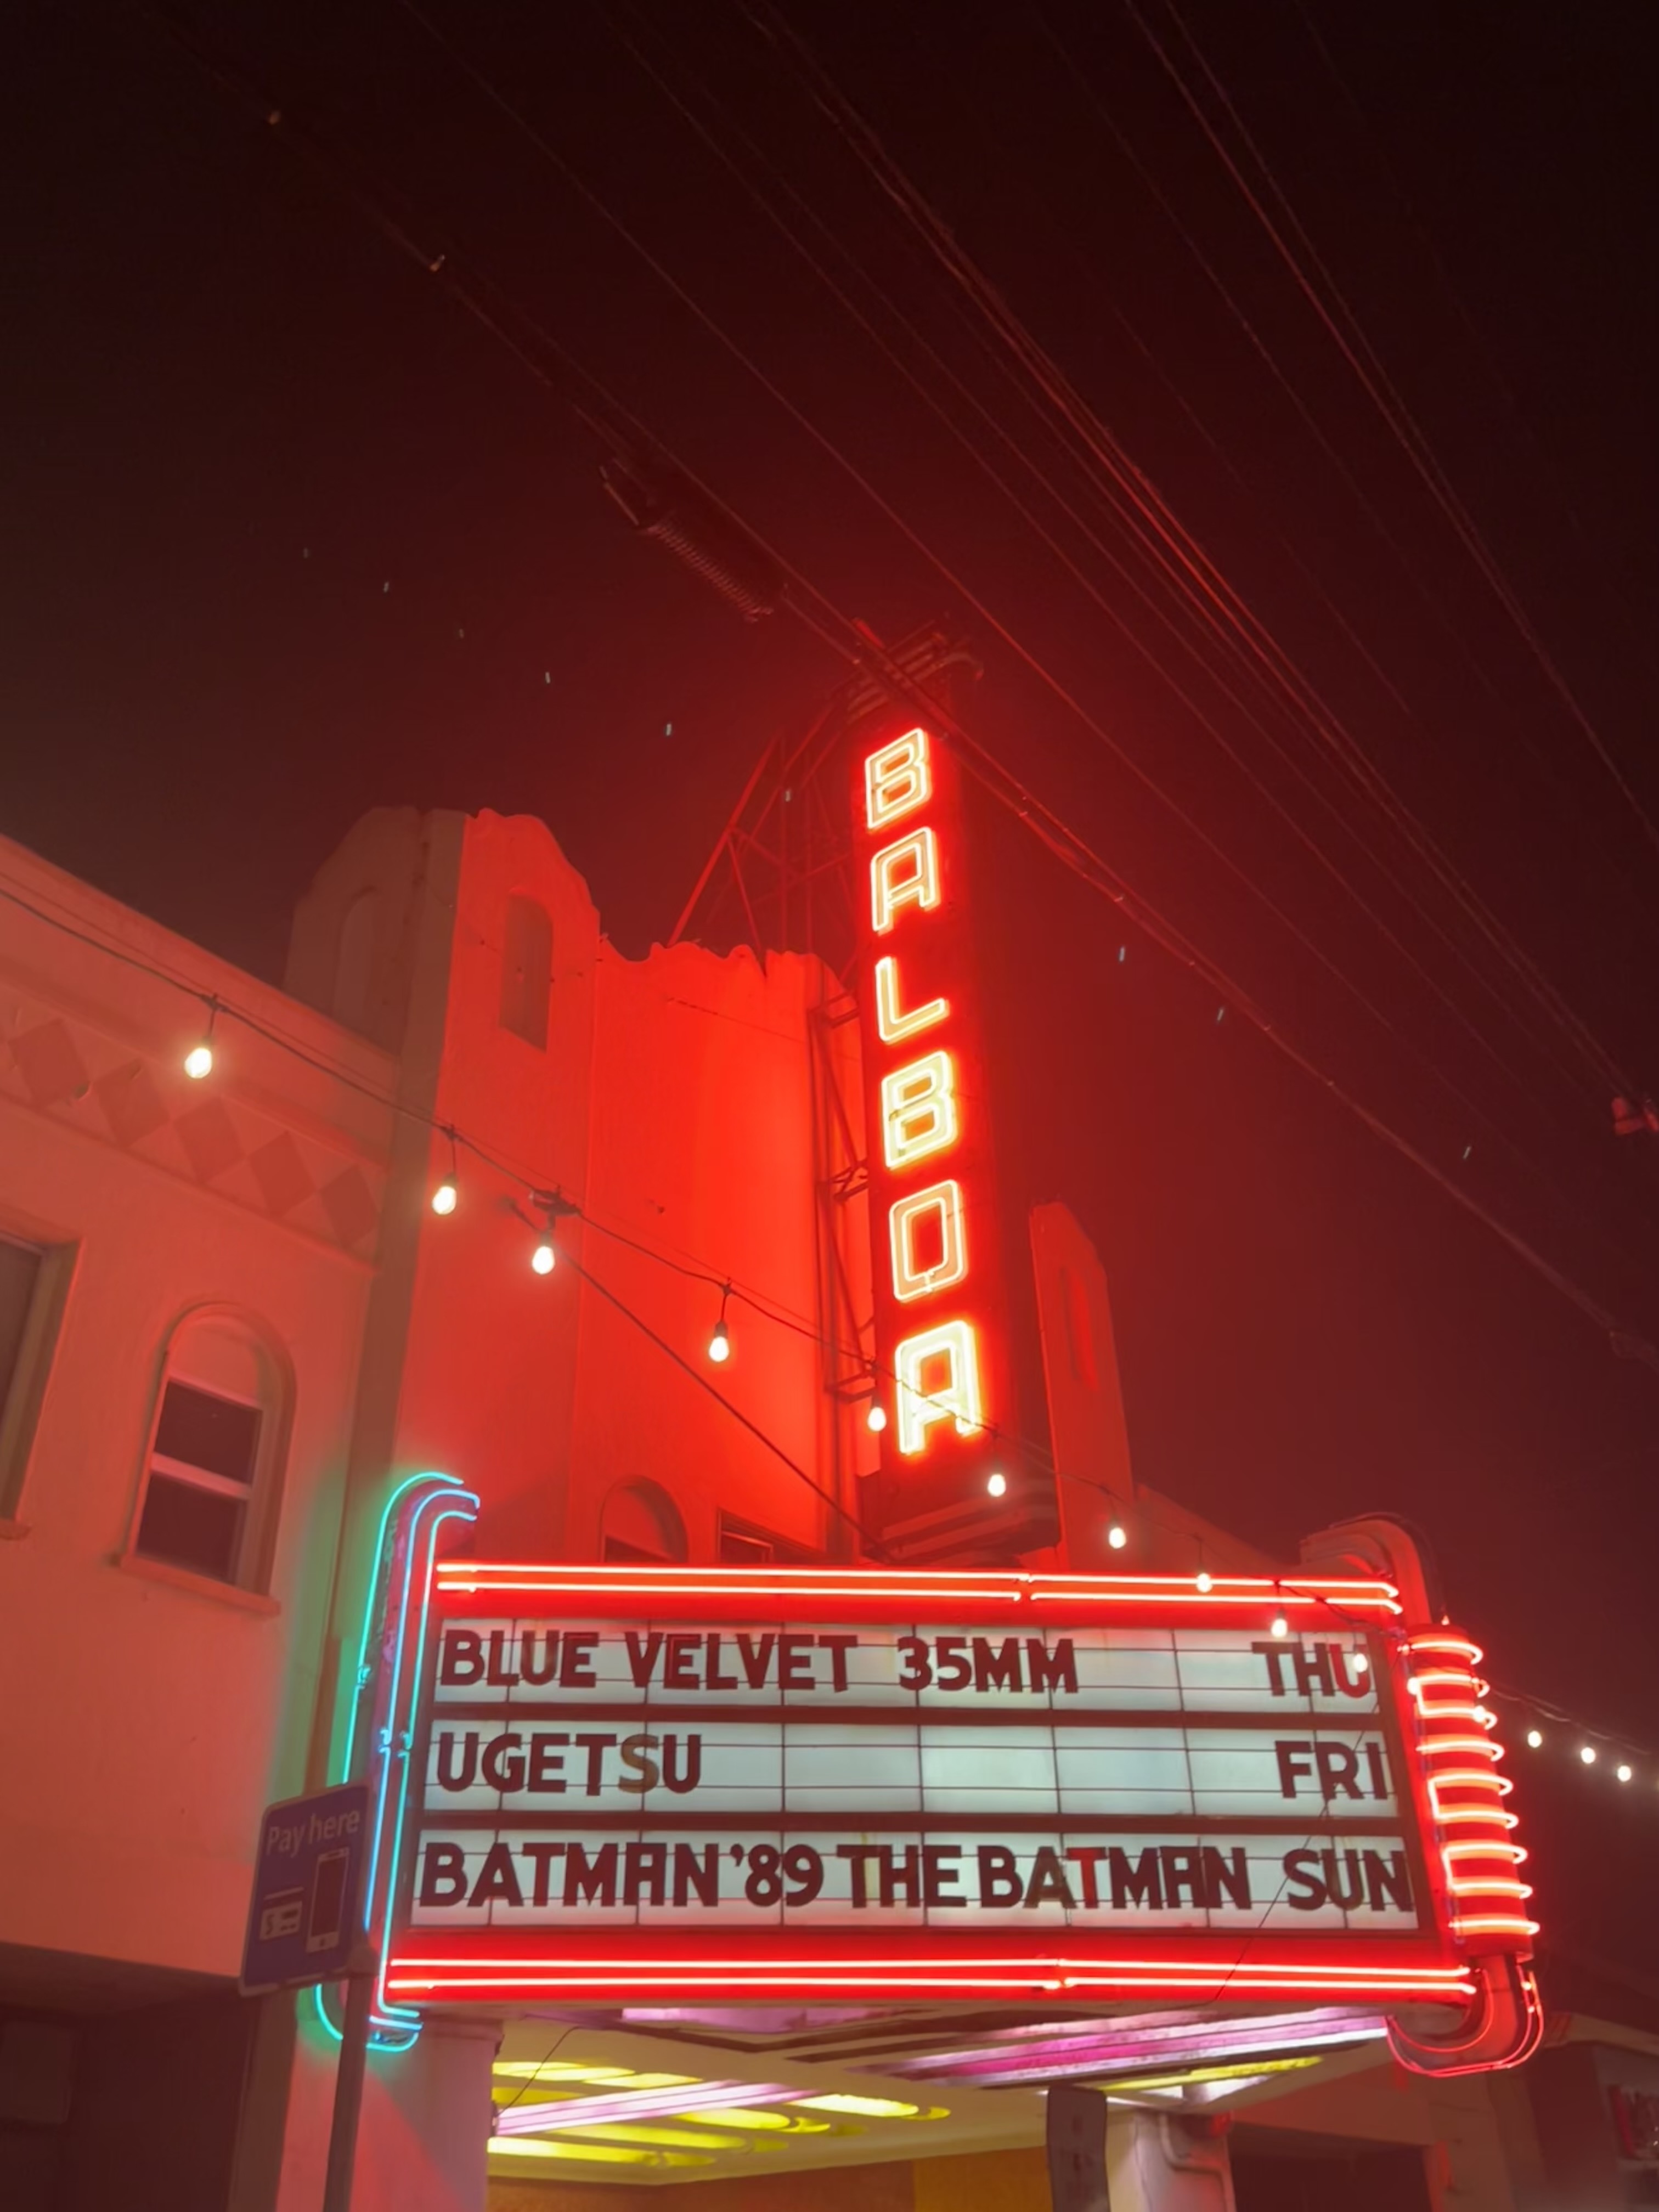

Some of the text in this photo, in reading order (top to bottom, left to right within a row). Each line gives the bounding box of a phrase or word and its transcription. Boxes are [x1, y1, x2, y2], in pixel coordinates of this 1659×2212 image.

[864, 726, 985, 1457] BALBOA
[440, 1629, 1370, 1699] BLUE VELVET 35MM THU
[437, 1732, 1389, 1801] UGETSU FRI
[266, 1810, 360, 1859] Pay here
[837, 1844, 967, 1909] THE
[978, 1844, 1252, 1910] BATMAN
[1282, 1849, 1414, 1912] SUN
